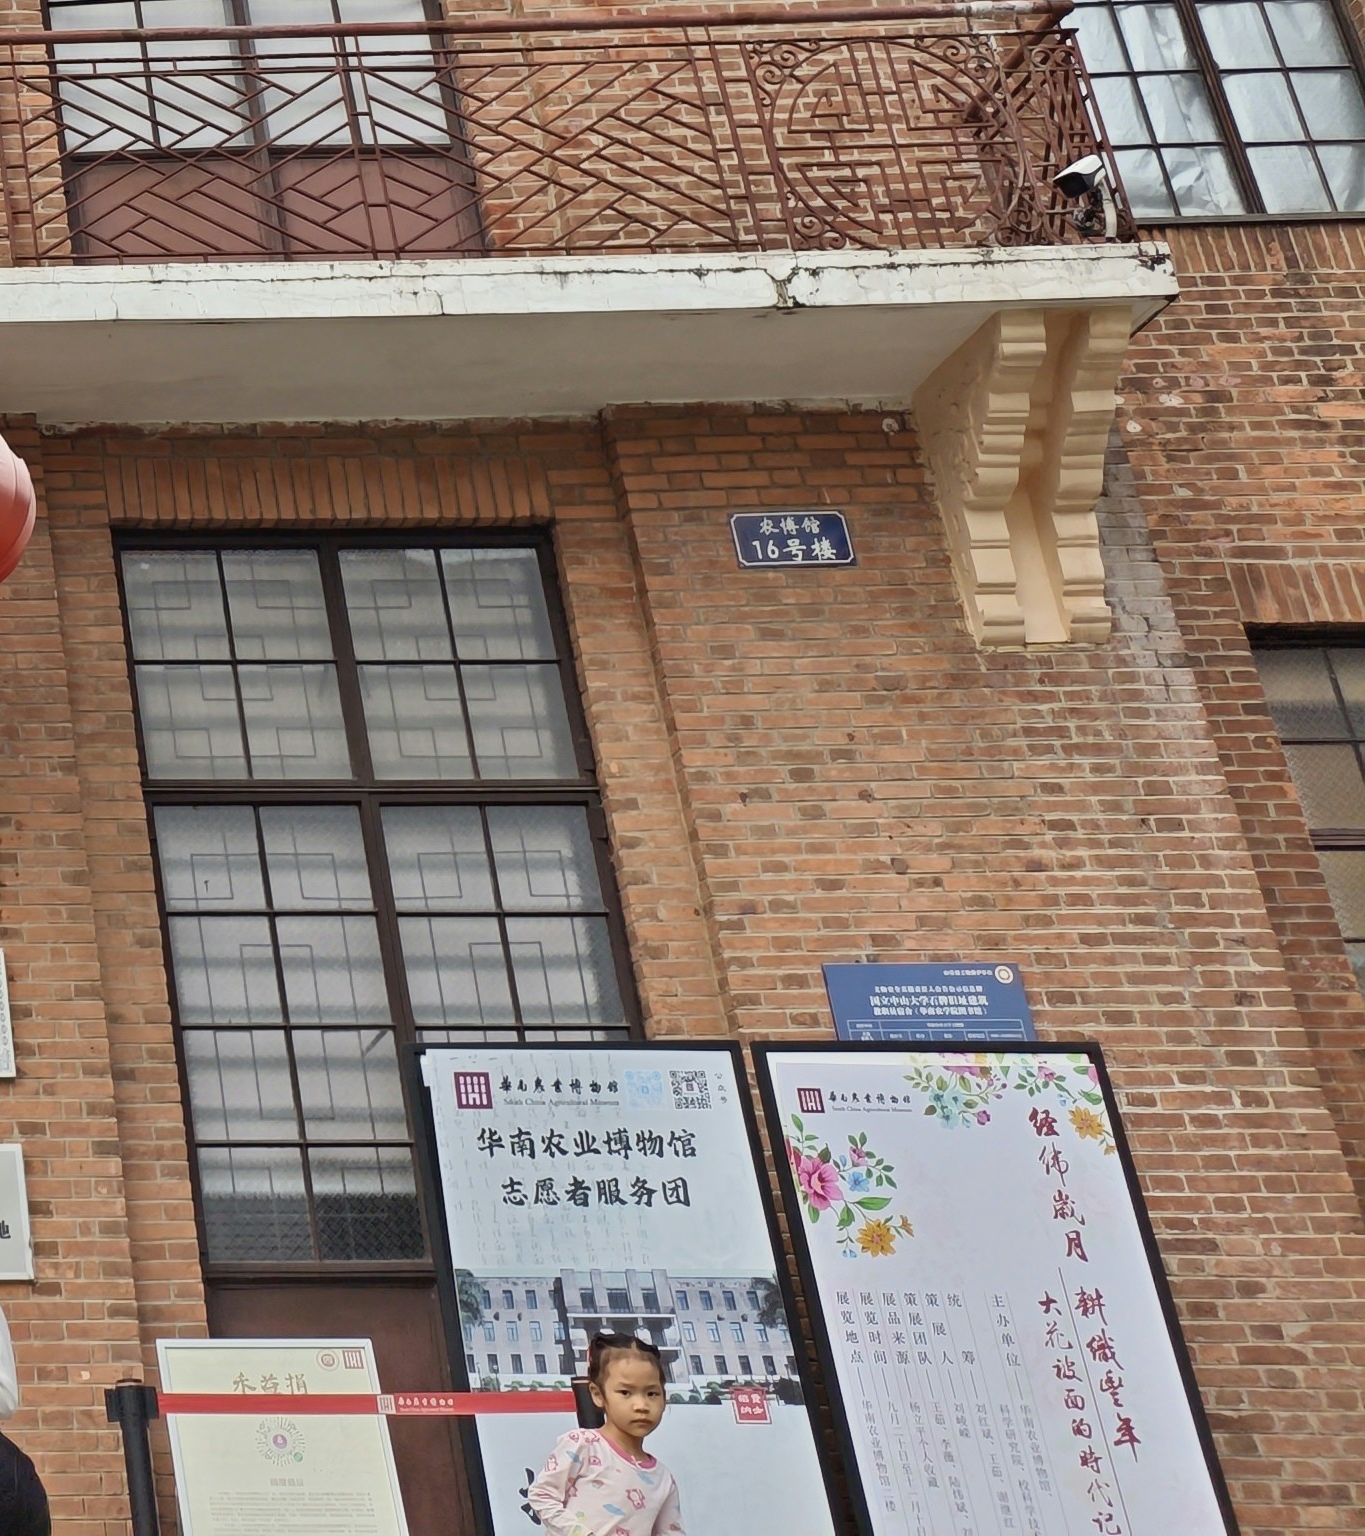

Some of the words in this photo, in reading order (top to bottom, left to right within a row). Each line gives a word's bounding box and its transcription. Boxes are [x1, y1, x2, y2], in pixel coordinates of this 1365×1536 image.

[751, 536, 837, 561] 16号楼
[759, 515, 820, 535] 农博馆
[477, 1127, 697, 1159] 华南农业博物馆
[501, 1176, 692, 1208] 志愿者服务团
[836, 1291, 864, 1363] 展览地点
[859, 1292, 887, 1364] 展览时间
[882, 1292, 910, 1364] 展品来源
[903, 1293, 933, 1364] 策展团队
[992, 1294, 1021, 1366] 主办单位
